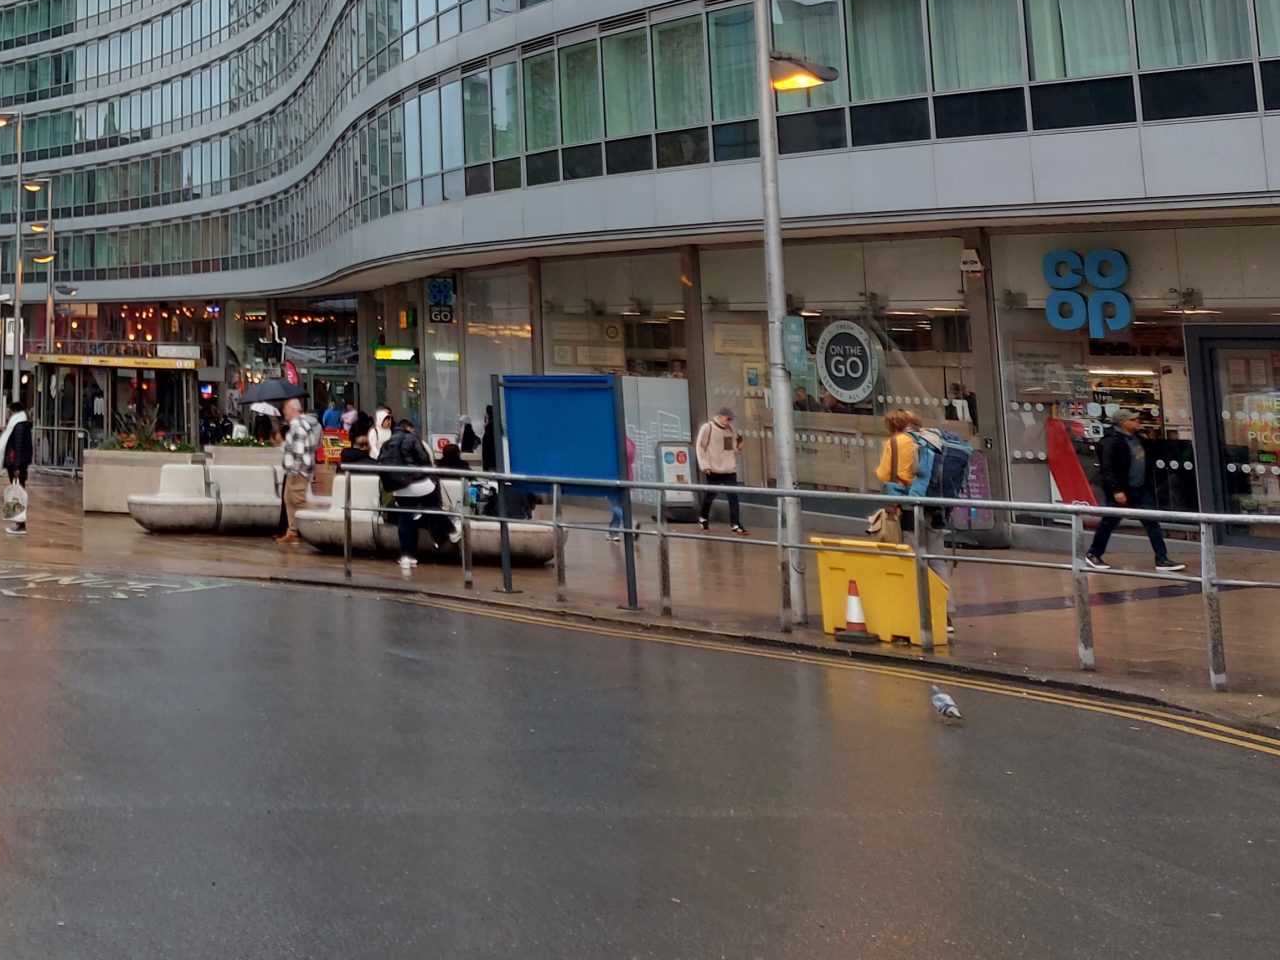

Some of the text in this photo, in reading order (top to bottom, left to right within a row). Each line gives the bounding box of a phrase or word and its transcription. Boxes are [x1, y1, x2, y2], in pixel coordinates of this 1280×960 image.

[431, 312, 451, 321] GO
[829, 345, 863, 356] ON THE
[831, 356, 863, 378] GO
